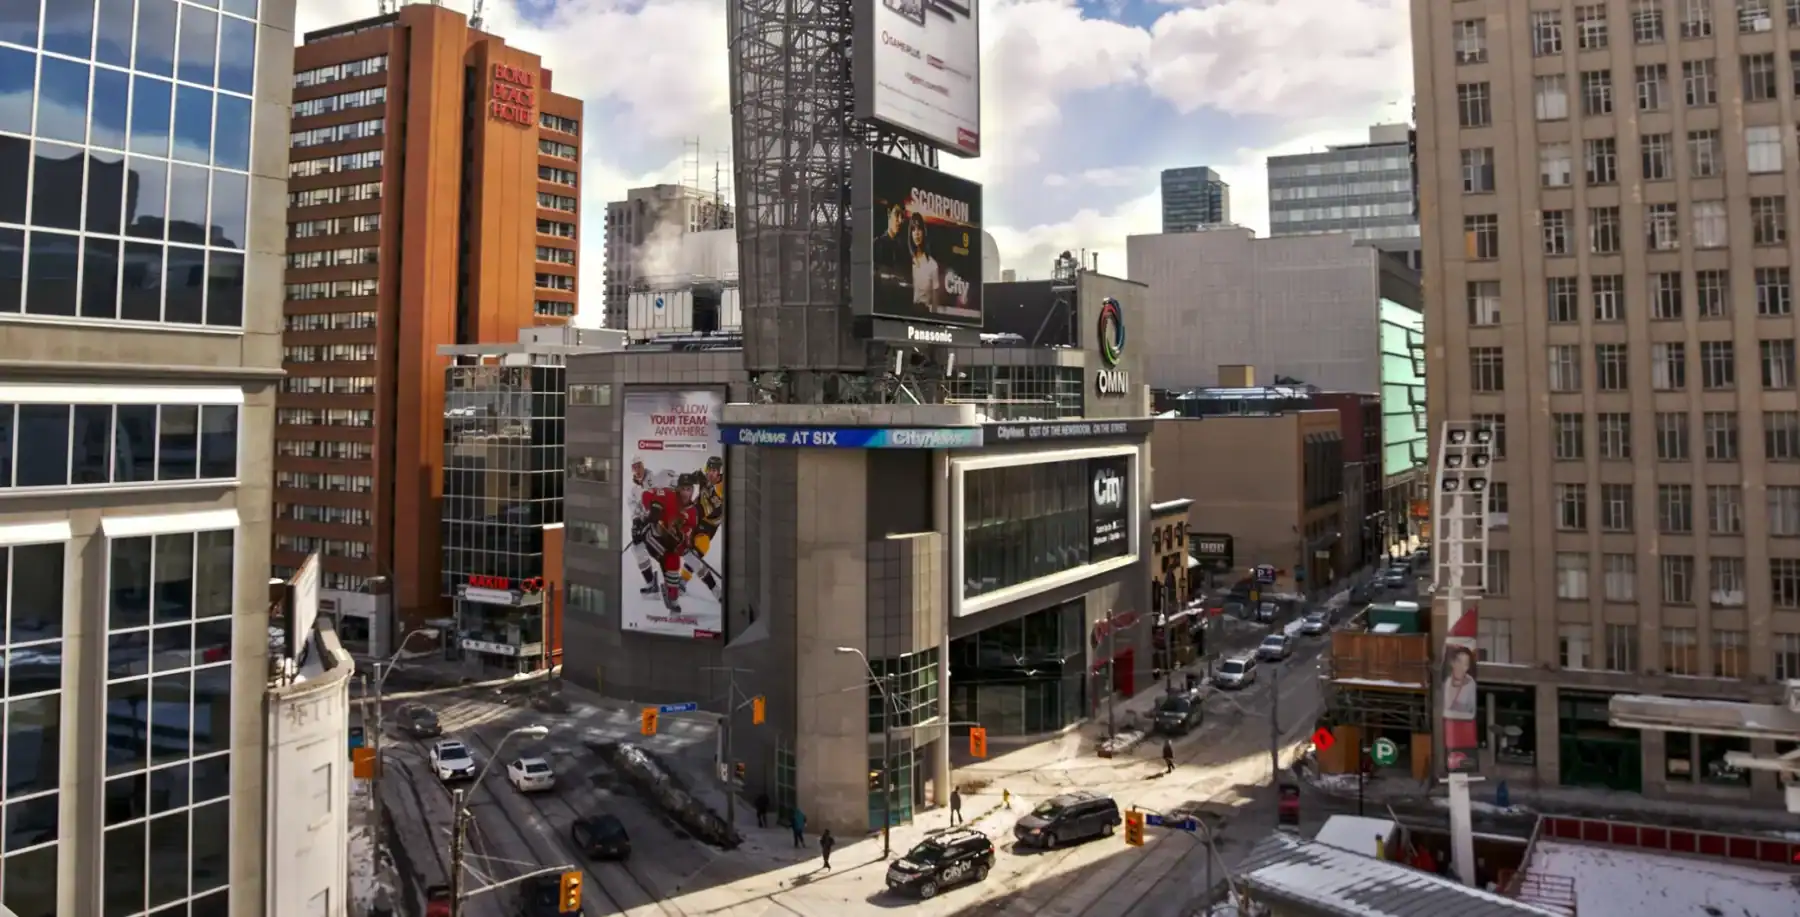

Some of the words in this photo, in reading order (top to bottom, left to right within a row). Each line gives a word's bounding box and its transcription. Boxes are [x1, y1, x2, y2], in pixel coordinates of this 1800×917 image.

[911, 187, 969, 222] SCORPION
[945, 271, 970, 305] City
[908, 325, 952, 343] Panasonic
[1098, 369, 1129, 393] OMNI
[670, 403, 709, 414] FOLLOW
[651, 415, 676, 425] YOUR
[679, 415, 709, 426] TEAM.
[739, 428, 787, 445] CityNews
[792, 430, 809, 444] AT
[813, 431, 837, 445] SIX
[1094, 467, 1124, 509] City
[1376, 742, 1394, 760] P
